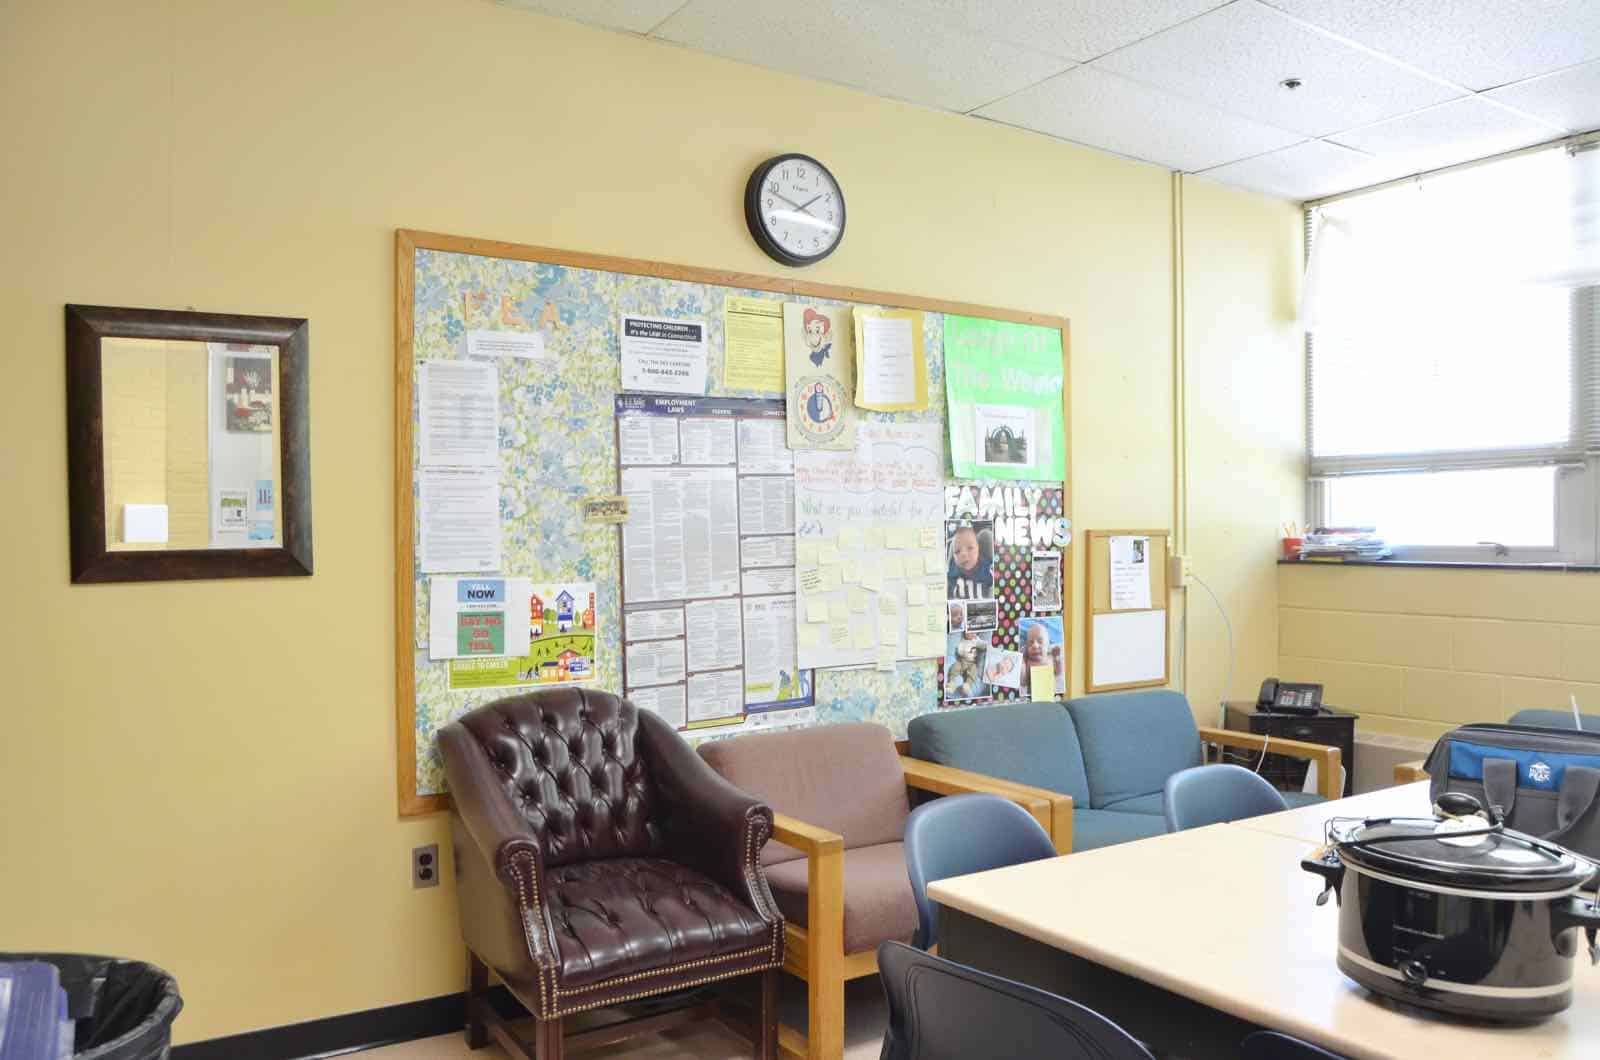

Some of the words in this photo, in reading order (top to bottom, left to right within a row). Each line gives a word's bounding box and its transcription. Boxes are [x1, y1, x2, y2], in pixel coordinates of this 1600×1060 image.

[782, 169, 789, 180] 11
[796, 167, 806, 178] 12
[768, 181, 780, 192] 10
[767, 199, 774, 208] 9
[770, 216, 777, 226] 8
[783, 231, 789, 241] 7
[629, 321, 662, 330] PROTECTING
[663, 324, 688, 332] CHILDREN
[655, 399, 697, 407] EMPLOYMENT
[667, 406, 684, 414] LAWS
[944, 486, 1042, 518] FAMILY
[995, 517, 1072, 547] NEWS
[467, 590, 496, 599] NOW
